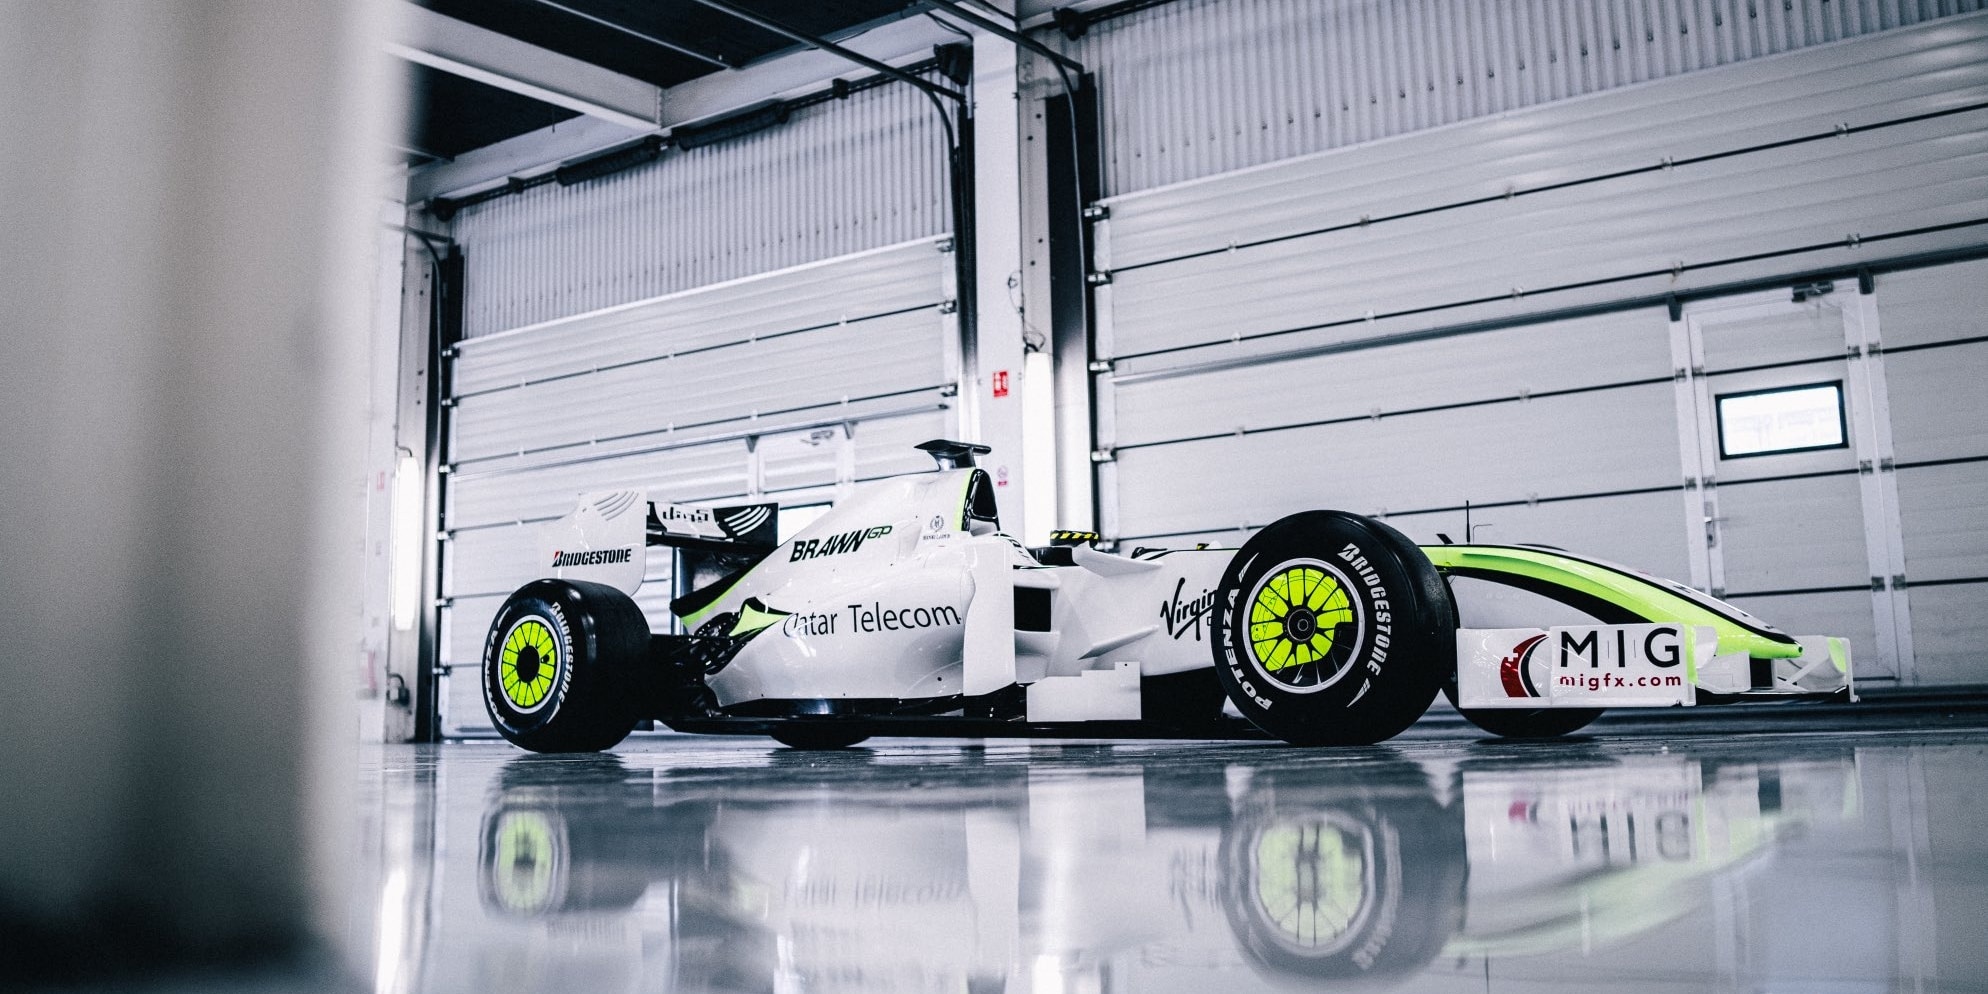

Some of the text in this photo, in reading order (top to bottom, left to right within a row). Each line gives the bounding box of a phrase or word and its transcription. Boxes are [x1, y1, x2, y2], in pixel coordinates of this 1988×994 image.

[552, 548, 632, 568] BRIDGESTONE
[789, 525, 893, 562] BRAWN GP
[848, 601, 961, 633] Telecom
[1337, 543, 1392, 676] BRIDGESTONE
[549, 601, 574, 703] BRIDGESTONE
[1222, 588, 1273, 710] POTENZA
[1560, 627, 1681, 669] MIG
[1559, 672, 1682, 691] migfx.com
